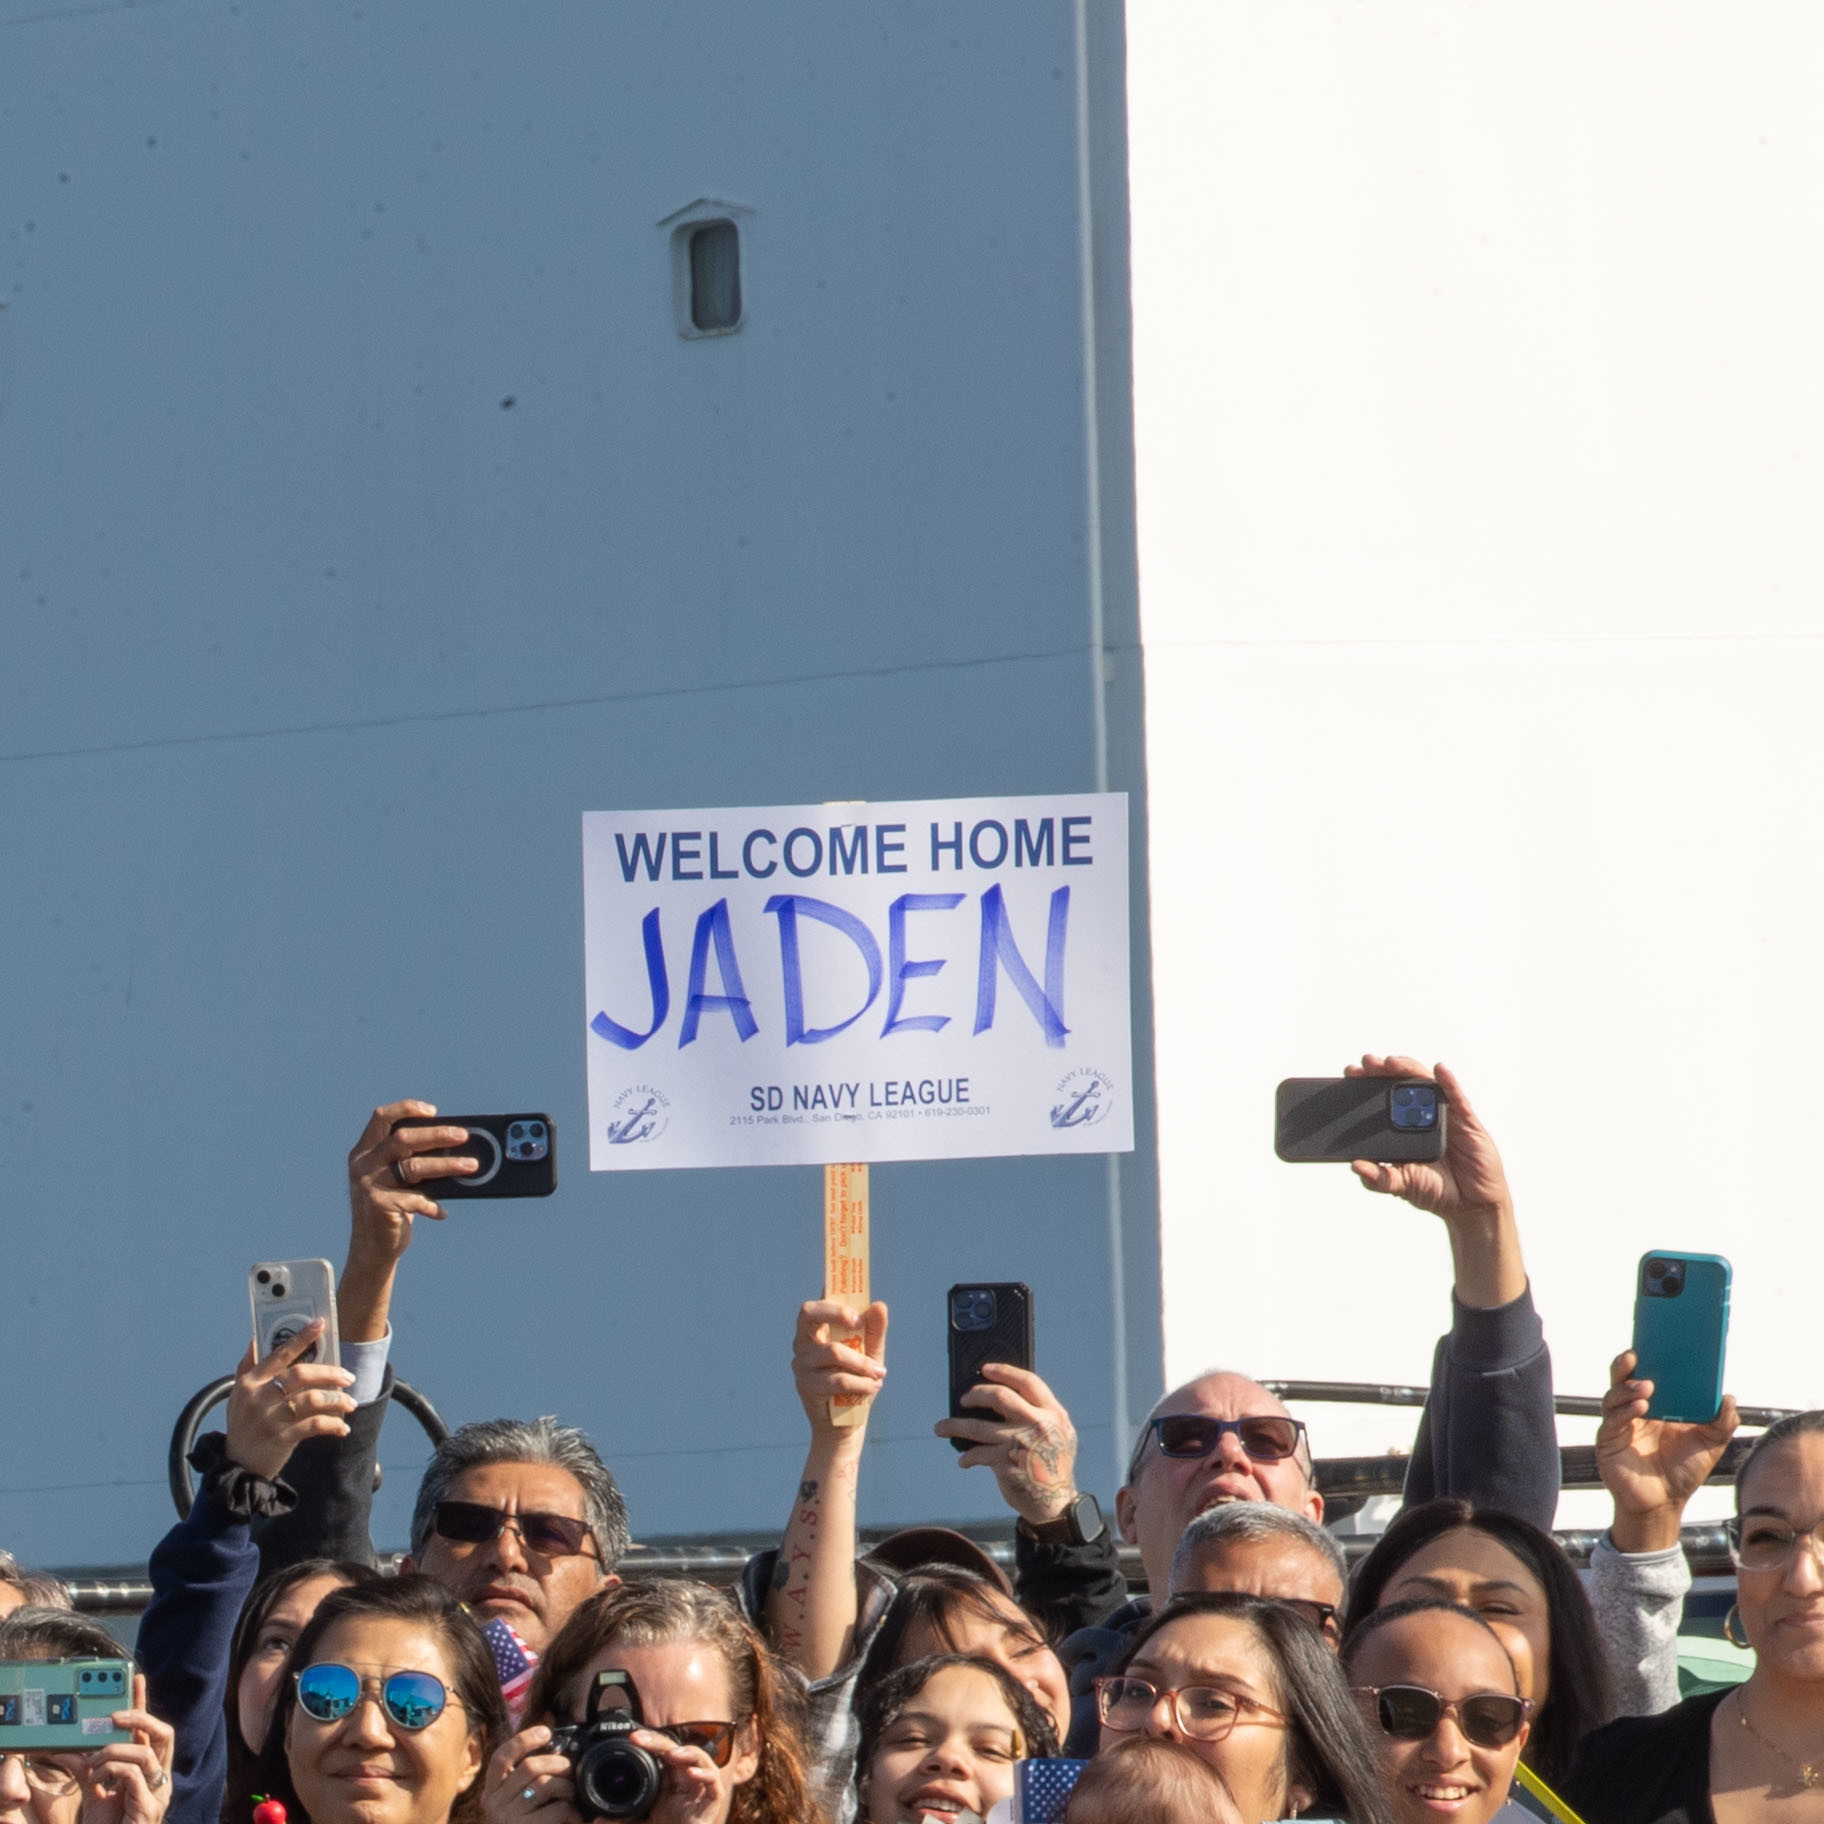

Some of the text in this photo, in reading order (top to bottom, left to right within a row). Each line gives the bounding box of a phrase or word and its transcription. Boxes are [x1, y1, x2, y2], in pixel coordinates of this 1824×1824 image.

[614, 815, 1094, 883] WELCOME HOME
[590, 882, 1072, 1051] JADEN
[613, 1084, 671, 1110] NAVY LEAGUE
[749, 1078, 971, 1112] SD NAVY LEAGUE
[729, 1115, 754, 1126] 2115
[757, 1114, 779, 1125] Park
[812, 1113, 832, 1123] San
[867, 1110, 883, 1121] CA
[885, 1109, 915, 1119] 92101
[599, 1721, 632, 1732] Nikon
